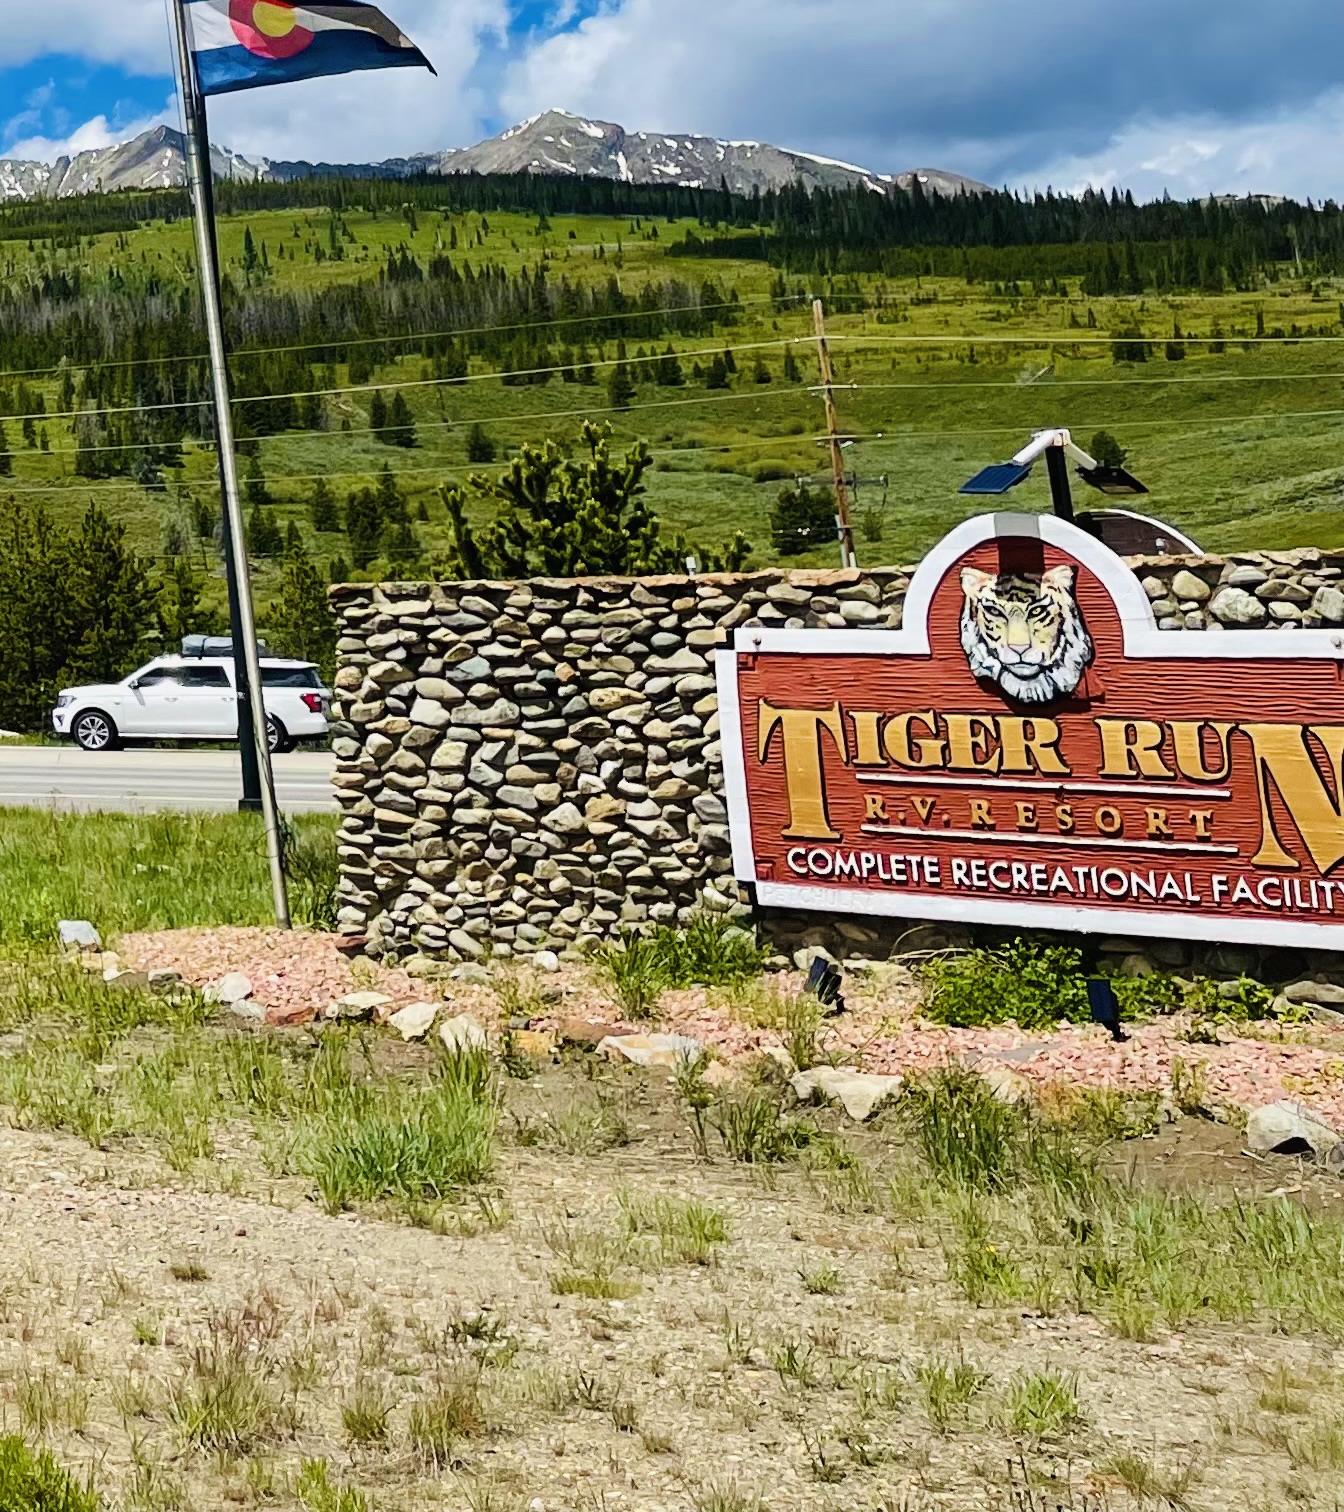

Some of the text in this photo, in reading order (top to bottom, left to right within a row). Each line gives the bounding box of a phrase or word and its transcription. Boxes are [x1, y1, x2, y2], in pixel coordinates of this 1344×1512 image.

[758, 697, 1344, 877] TIGER RUN
[864, 793, 1214, 837] R.V. RESORT
[786, 846, 1344, 910] COMPLETE RECREATIONAL FACILIT
